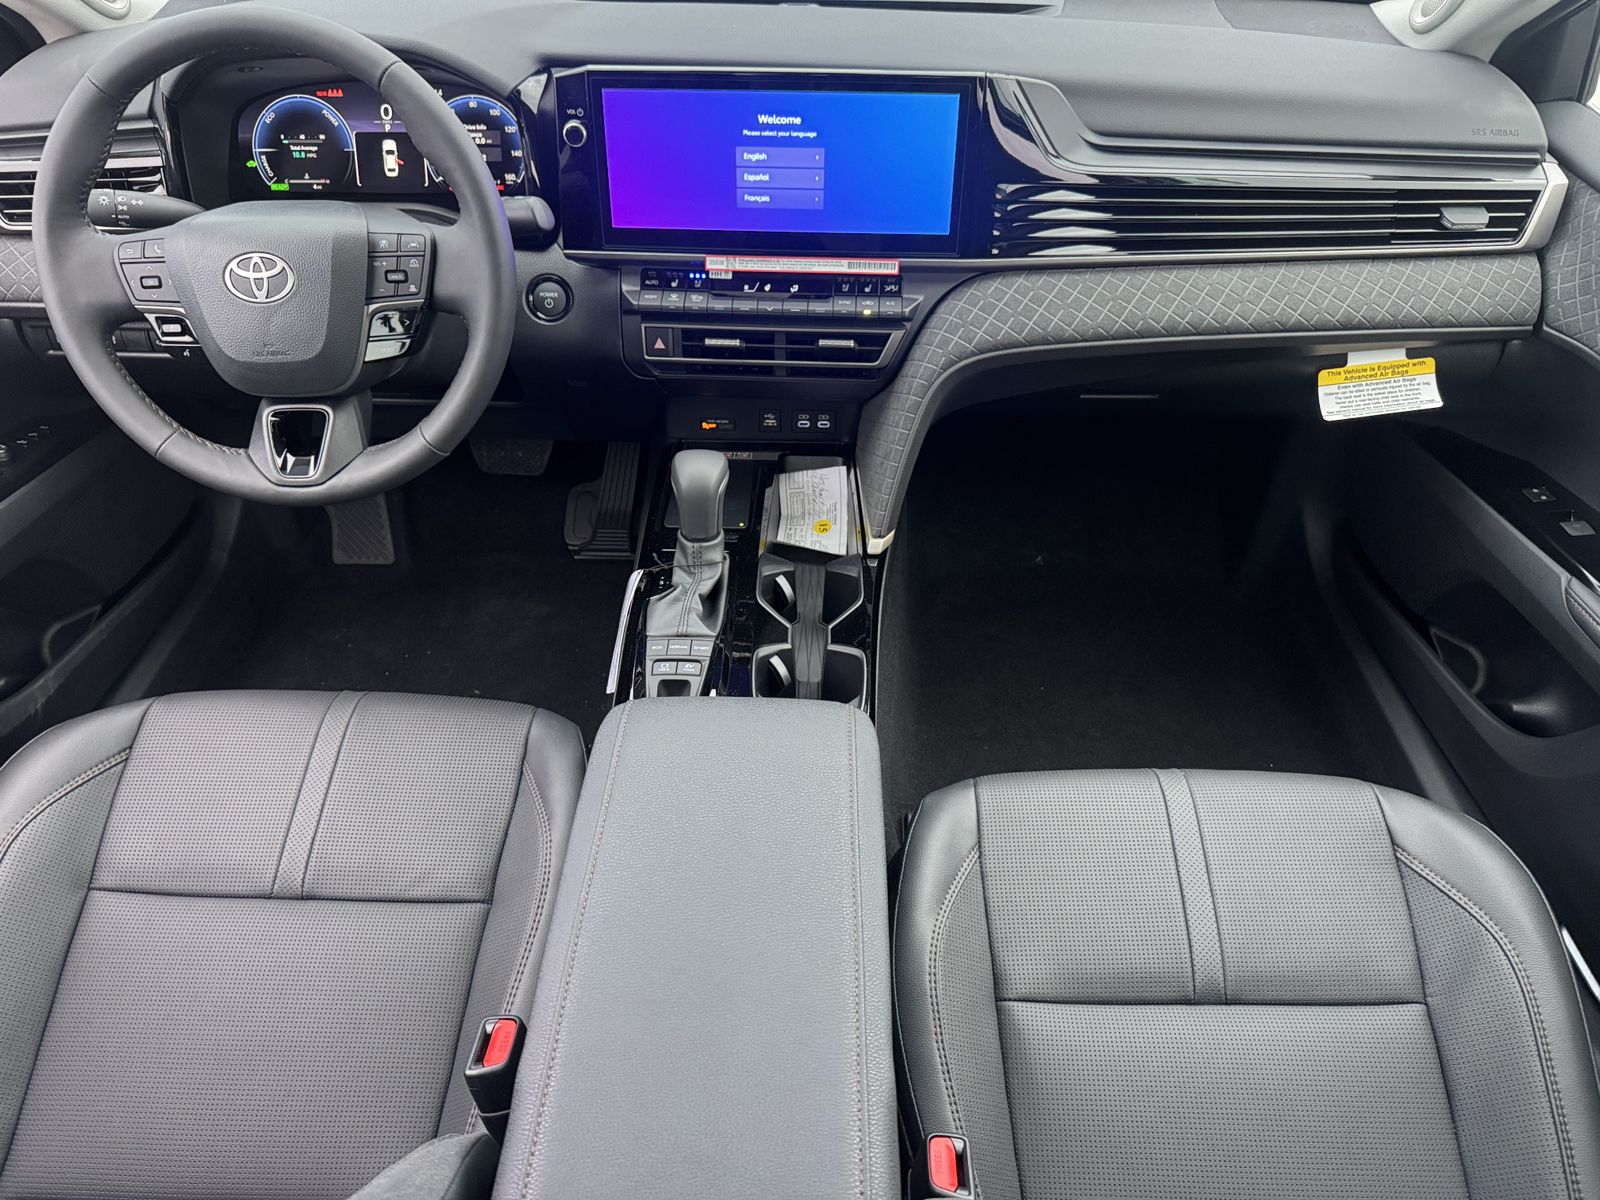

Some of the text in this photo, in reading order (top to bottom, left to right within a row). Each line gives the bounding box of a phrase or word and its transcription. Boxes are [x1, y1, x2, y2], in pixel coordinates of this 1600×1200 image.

[380, 104, 392, 120] 0
[265, 112, 275, 124] ECO
[322, 109, 339, 127] POWER
[758, 114, 802, 125] Welcome
[385, 124, 391, 132] P
[744, 152, 767, 161] English
[744, 173, 770, 182] Español
[744, 194, 770, 203] Français
[1378, 362, 1410, 371] Equipped
[1344, 373, 1377, 381] Advanced
